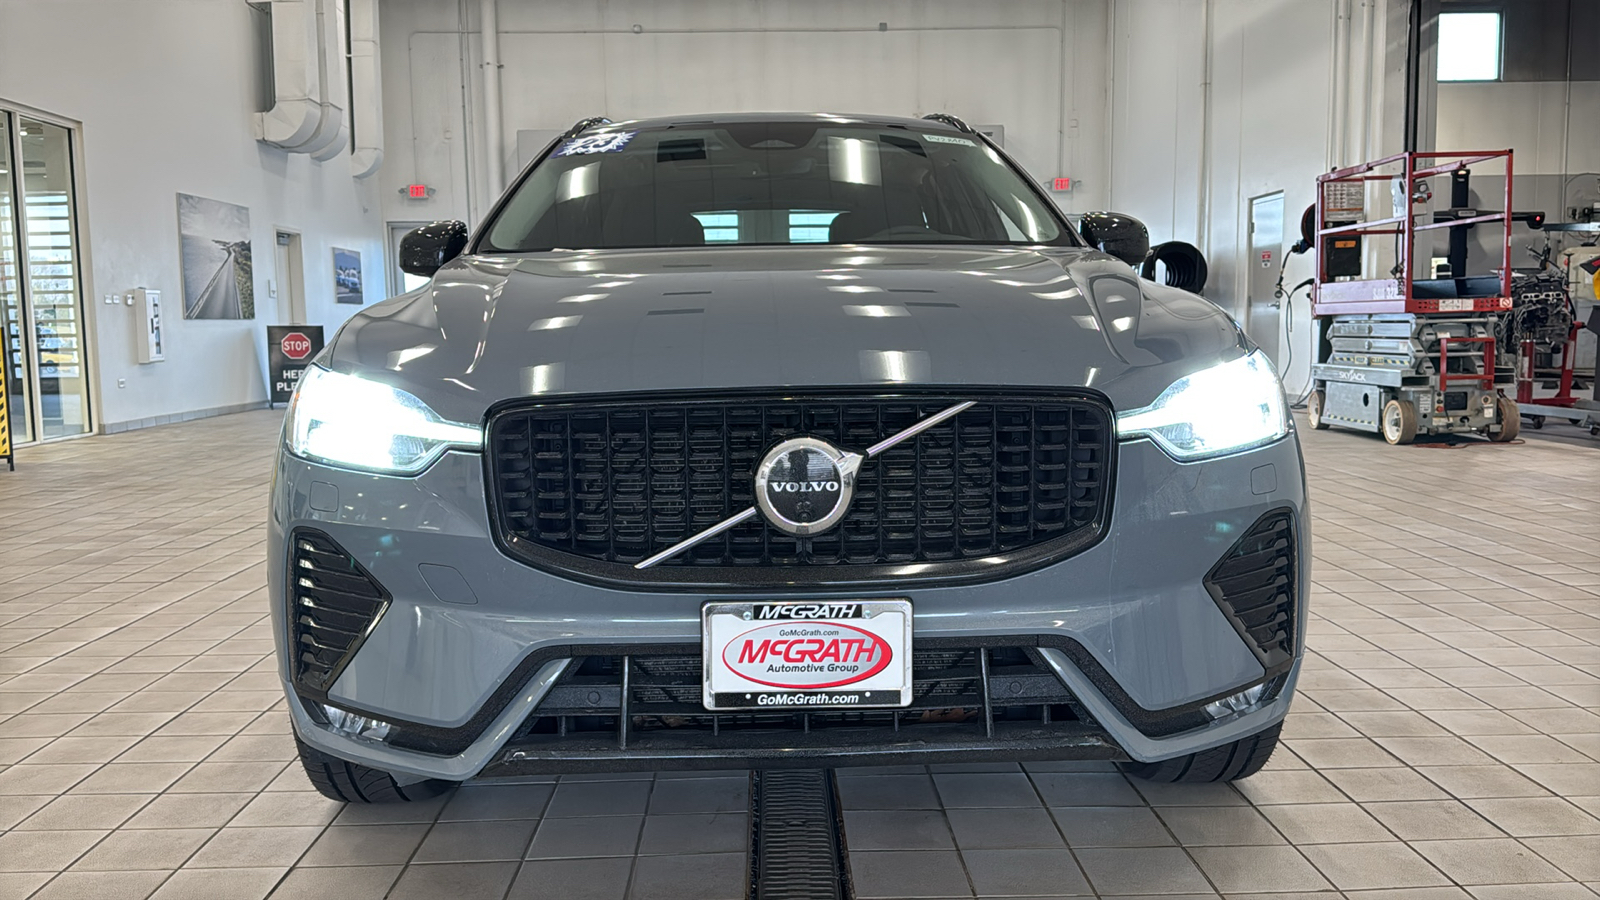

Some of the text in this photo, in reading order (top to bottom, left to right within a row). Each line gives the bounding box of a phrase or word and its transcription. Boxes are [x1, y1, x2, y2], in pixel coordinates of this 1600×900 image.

[284, 341, 309, 351] STOP
[1339, 369, 1366, 381] SKYJACK
[770, 481, 839, 492] VOLVO
[779, 629, 839, 637] GoMcGrath.com
[766, 663, 859, 674] Automotive Group
[757, 693, 859, 706] GoMcGrath.com
